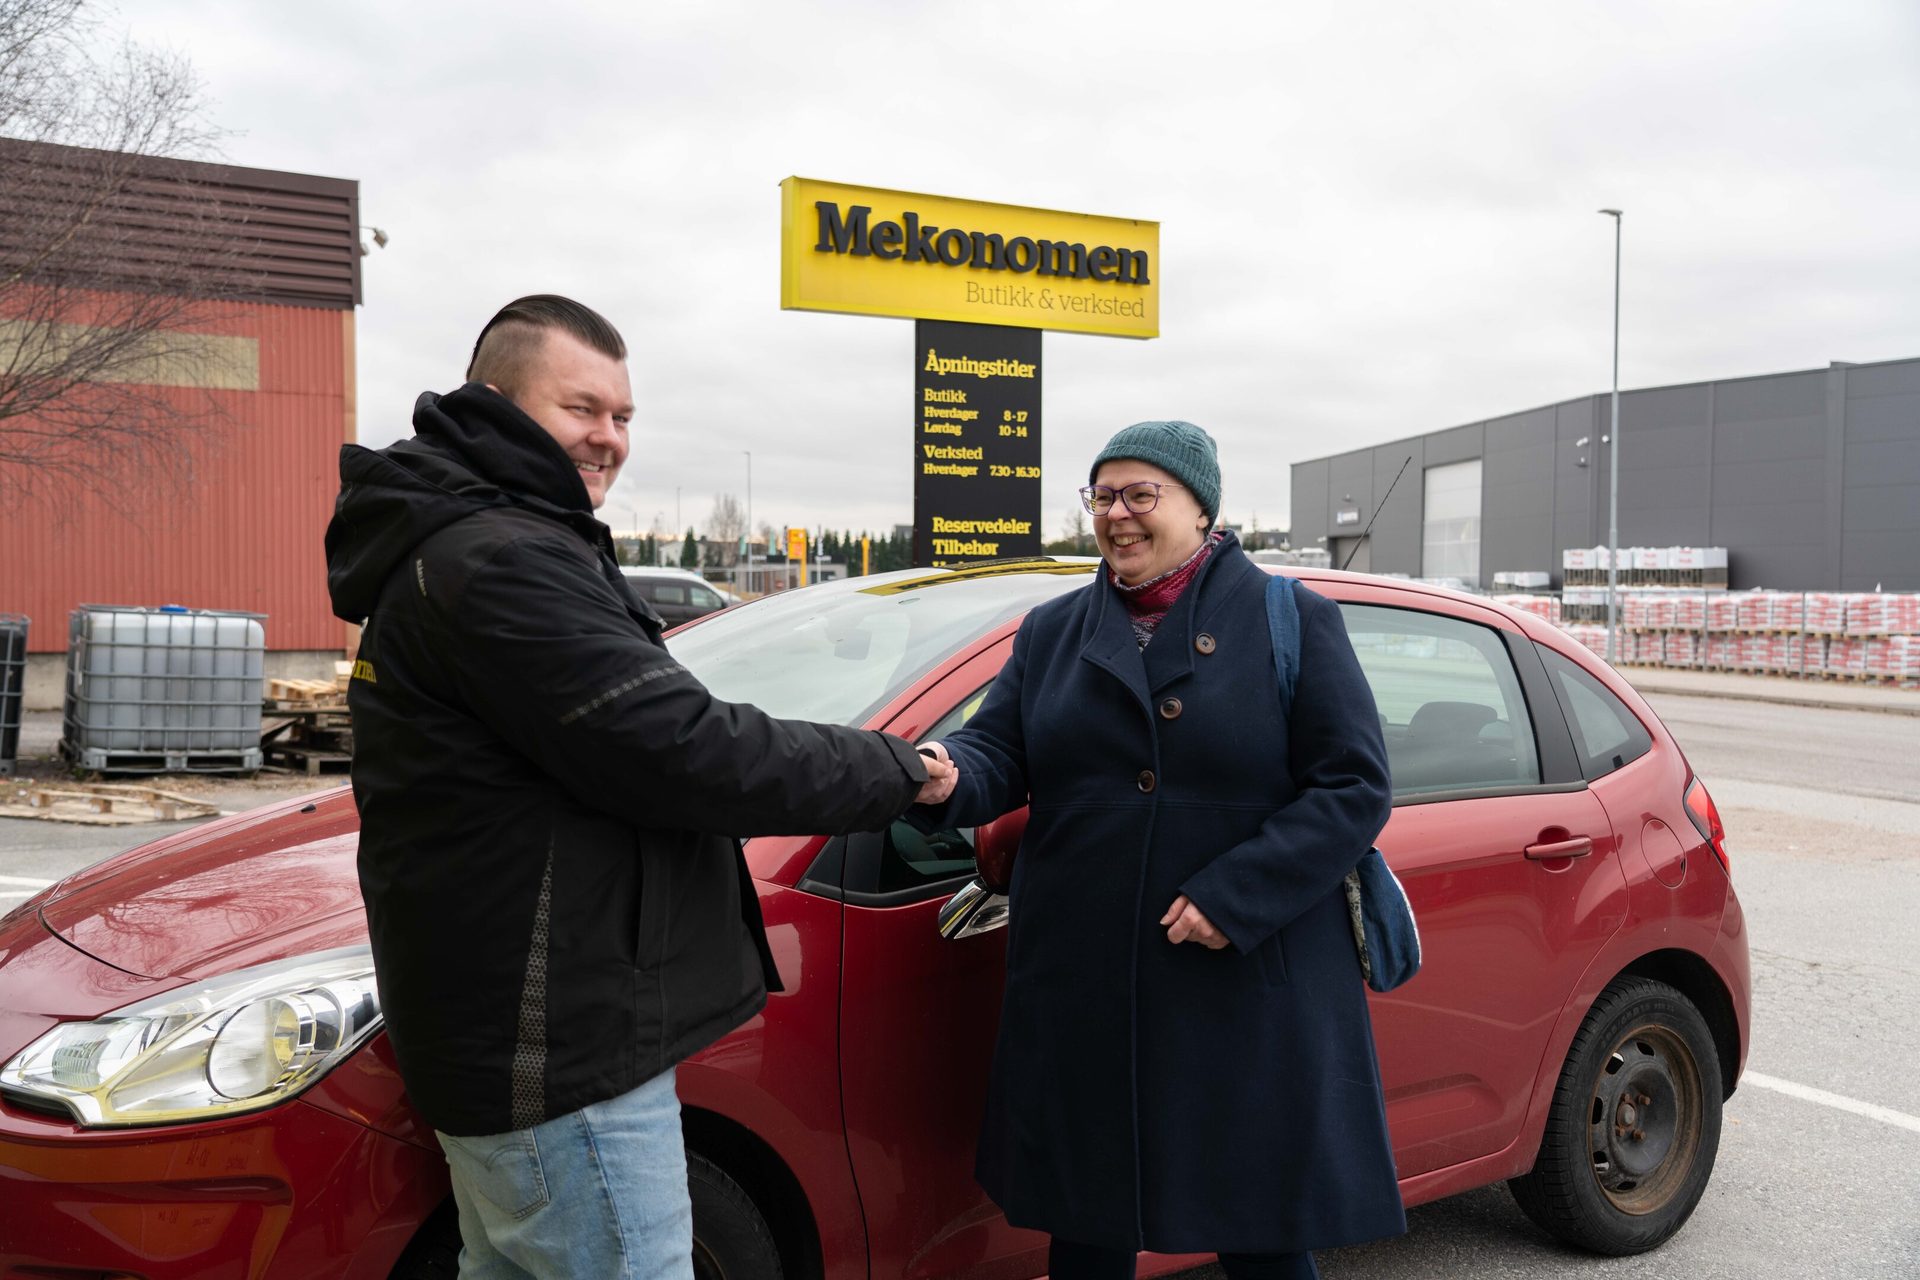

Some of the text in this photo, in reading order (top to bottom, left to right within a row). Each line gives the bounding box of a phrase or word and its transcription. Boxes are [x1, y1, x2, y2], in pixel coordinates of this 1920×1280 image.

[814, 201, 1150, 285] Mekonomen
[966, 281, 1145, 318] Butikk & verksted
[924, 349, 1036, 378] Åpningstider
[924, 388, 967, 404] Butikk
[924, 406, 979, 422] Hverdager
[924, 422, 962, 437] Lørdag
[924, 445, 983, 461] Verksted
[923, 463, 979, 478] Hverdager
[933, 517, 1031, 535] Reservedeler
[932, 539, 999, 556] Tilbehør
